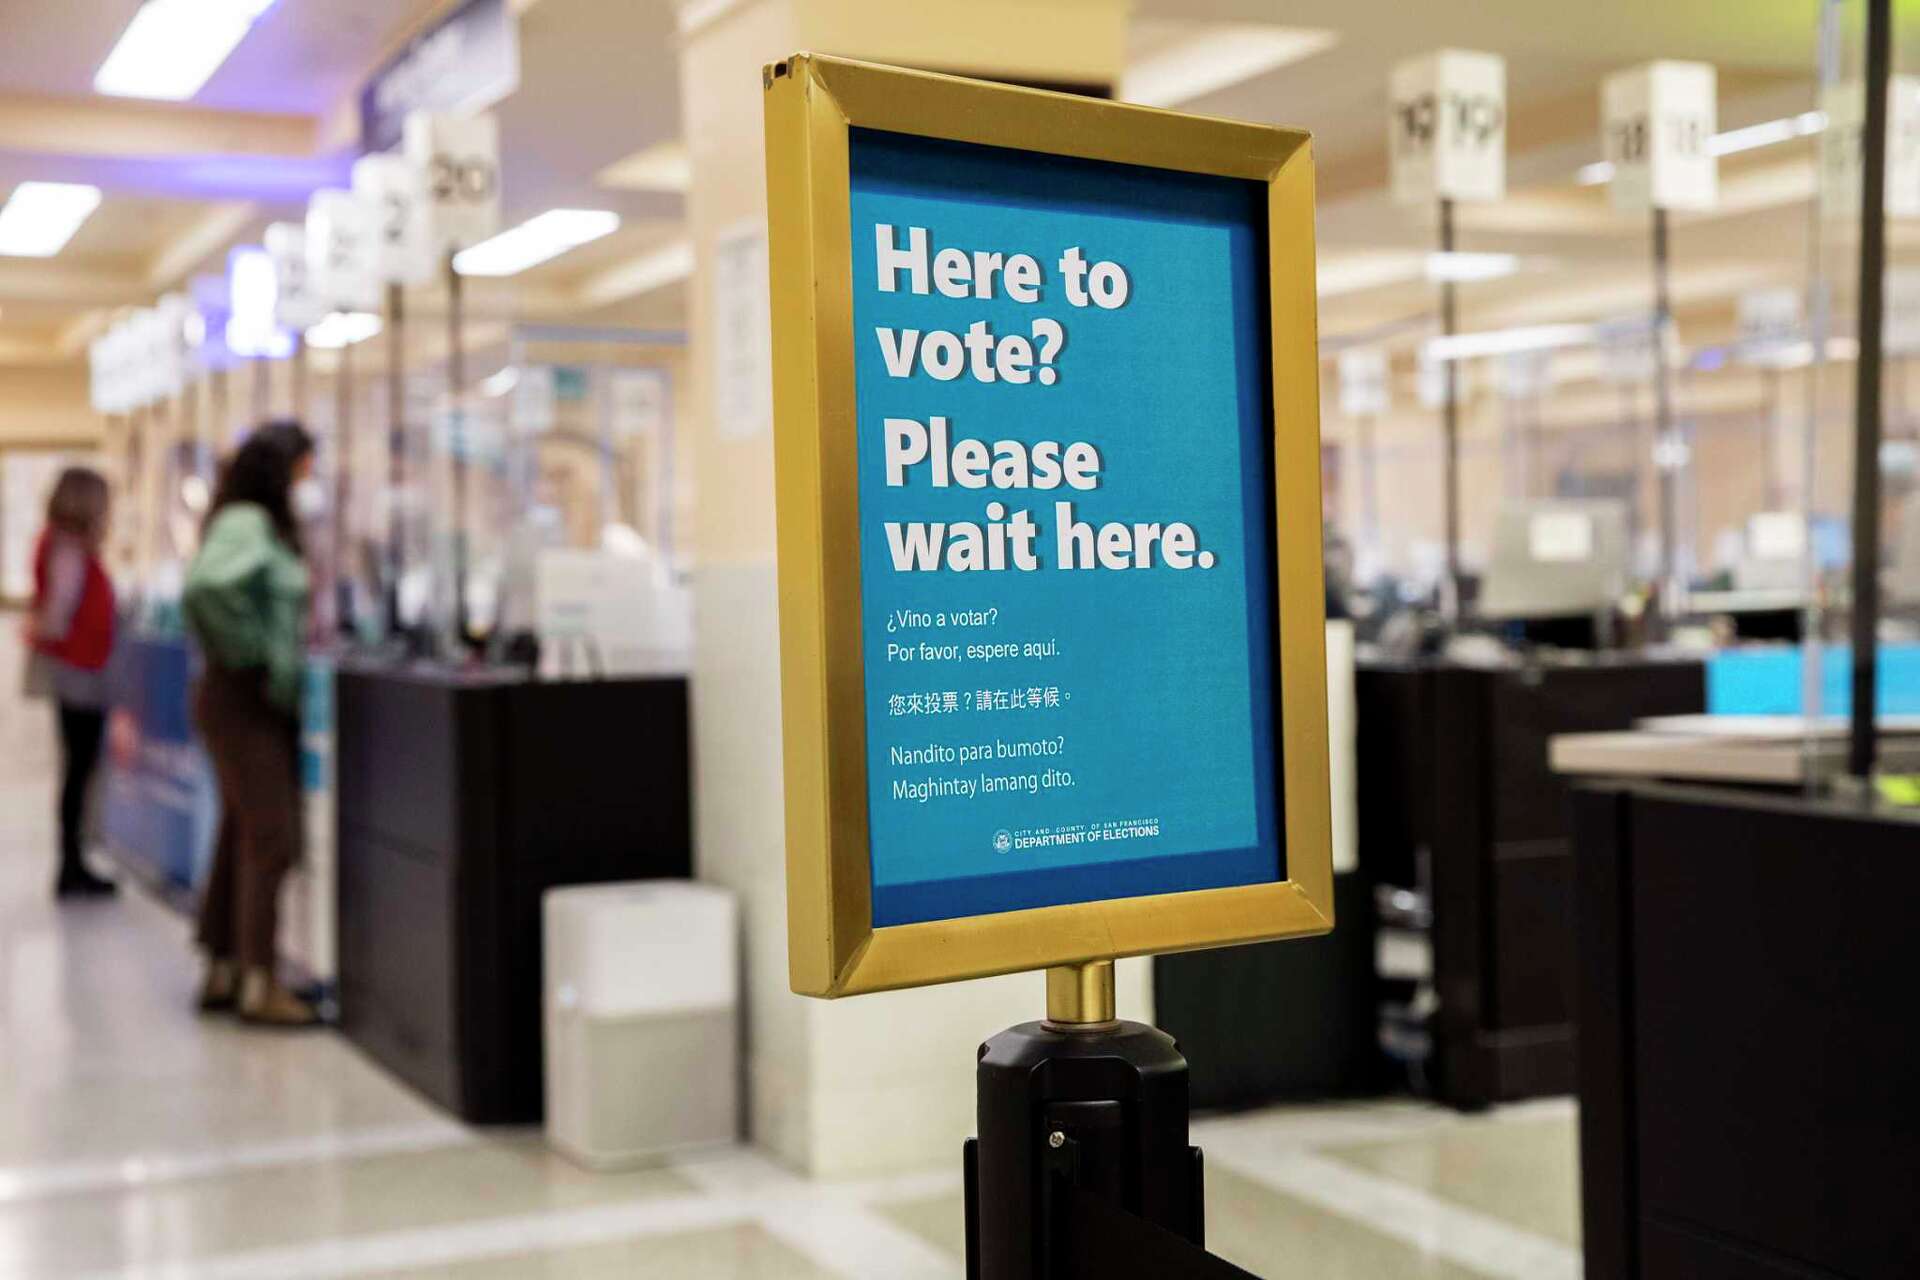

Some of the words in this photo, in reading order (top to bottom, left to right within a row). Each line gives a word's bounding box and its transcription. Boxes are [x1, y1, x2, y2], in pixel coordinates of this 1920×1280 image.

[428, 150, 494, 202] 20
[875, 223, 1042, 304] Here
[1058, 246, 1129, 310] to
[874, 317, 1064, 386] vote?
[883, 415, 1101, 491] Please
[883, 501, 1038, 572] wait
[1055, 501, 1215, 570] here.
[886, 609, 932, 633] ¿Vino
[935, 612, 947, 628] a
[950, 607, 998, 627] votar?
[887, 643, 915, 662] Por
[919, 642, 963, 662] favor,
[966, 642, 1019, 663] espere
[1022, 637, 1061, 661] aquí.
[890, 743, 955, 766] Nandito
[959, 744, 993, 766] para
[996, 735, 1065, 760] bumoto?
[892, 776, 977, 803] Maghintay
[981, 773, 1038, 794] lamang
[1041, 768, 1076, 788] dito.
[1014, 830, 1032, 838] CITY
[1055, 825, 1085, 834] COUNTY
[1091, 823, 1101, 831] OF
[1103, 821, 1118, 829] SAN
[1119, 817, 1159, 828] FRANCISCO
[1014, 832, 1088, 849] DEPARTMENT
[1087, 830, 1102, 842] OF
[1103, 825, 1160, 841] ELECTIONS
